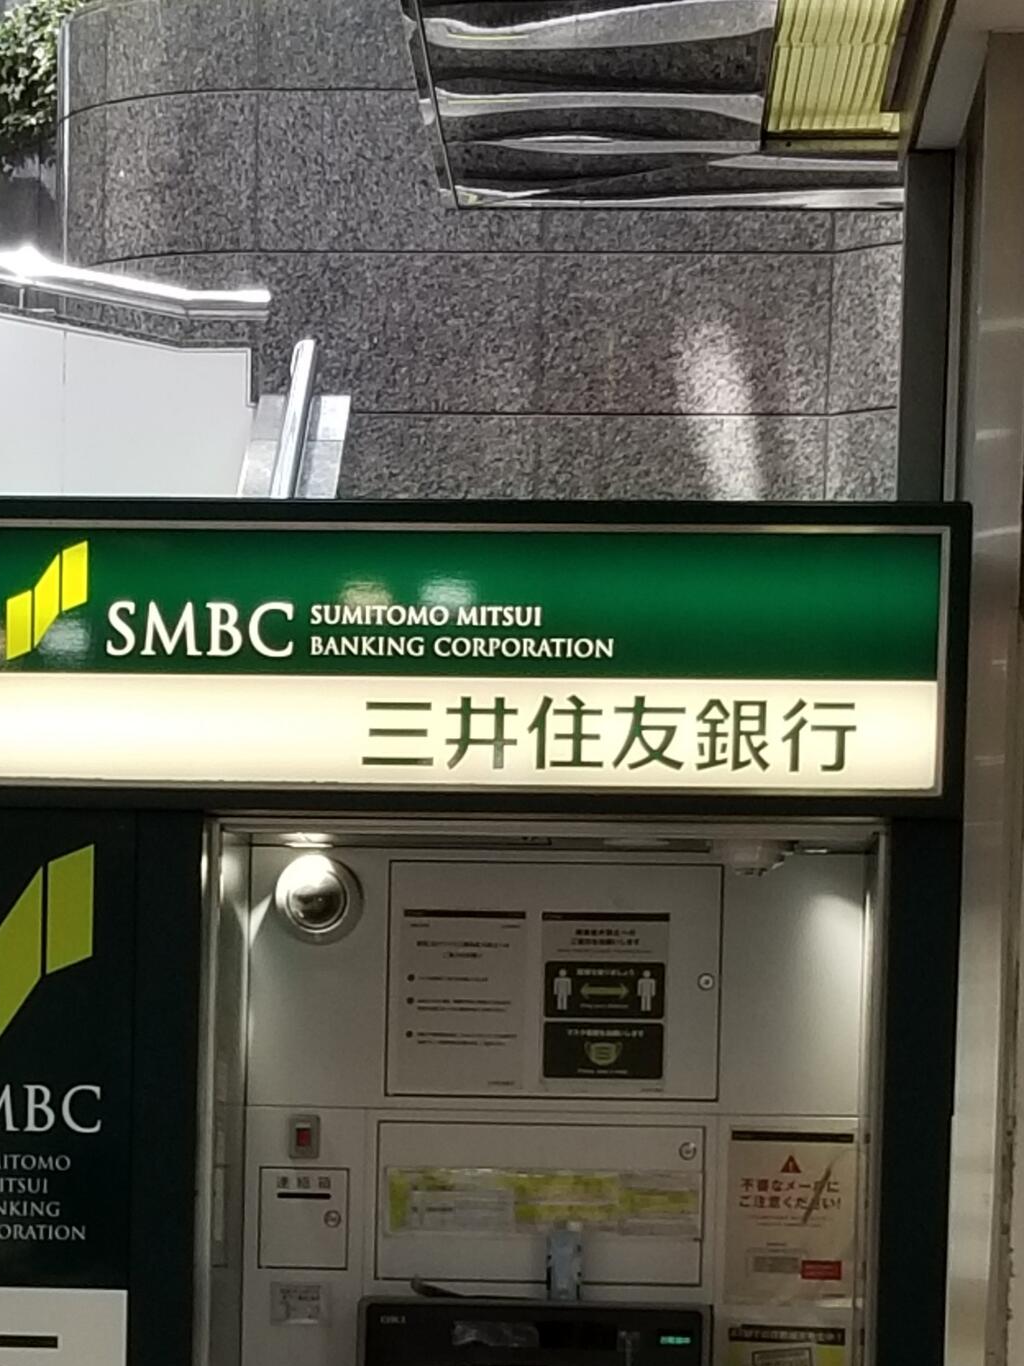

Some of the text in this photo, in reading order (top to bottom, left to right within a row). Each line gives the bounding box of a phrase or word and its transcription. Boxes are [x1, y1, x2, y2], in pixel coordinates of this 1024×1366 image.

[106, 601, 294, 661] SMBC
[310, 604, 542, 628] SUMITOMO MITSUI
[309, 636, 615, 660] BANKING CORPORATION
[361, 694, 859, 774] 三井住友銀行
